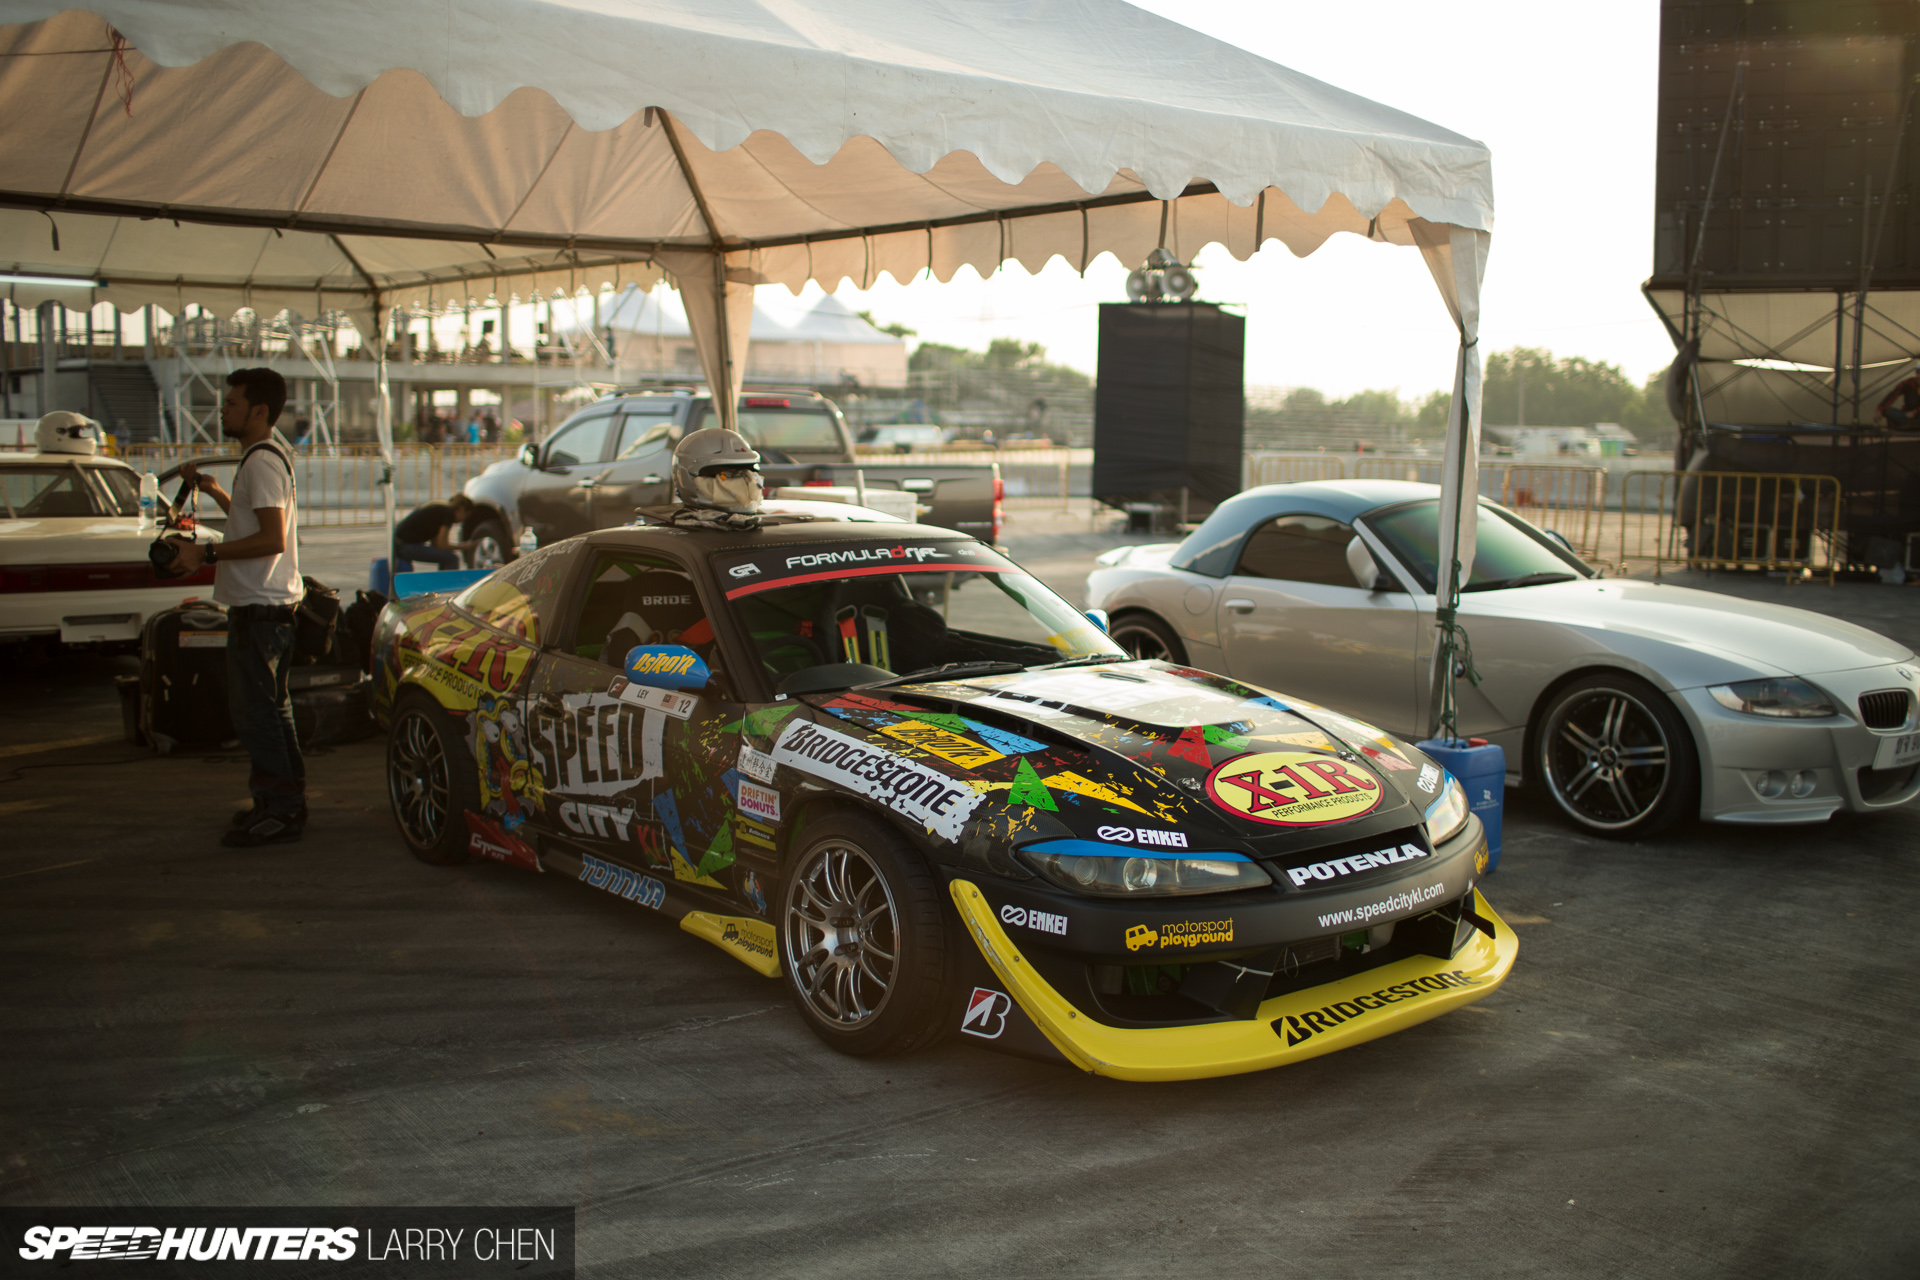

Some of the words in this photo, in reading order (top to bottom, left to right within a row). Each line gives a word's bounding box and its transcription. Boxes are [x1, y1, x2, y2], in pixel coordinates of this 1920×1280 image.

[642, 595, 691, 606] BRIDE
[637, 688, 649, 700] LEY
[678, 699, 692, 714] 12
[528, 702, 646, 791] SPEED
[781, 724, 964, 817] BRIDGESTONE
[741, 785, 777, 804] DRIFTIN'
[1218, 760, 1377, 813] X-1R
[1272, 798, 1334, 818] PERFORMANCE
[1334, 793, 1372, 806] PRODUCTS
[559, 801, 634, 842] CITY
[1136, 828, 1188, 848] ENKEI
[1287, 843, 1428, 886] POTENZA
[1318, 881, 1445, 928] www.speedcitykl.com
[1028, 909, 1067, 935] ENKEI
[1162, 917, 1234, 935] motorsport
[1160, 929, 1234, 949] playground
[1270, 970, 1483, 1047] BRIDGESTONE
